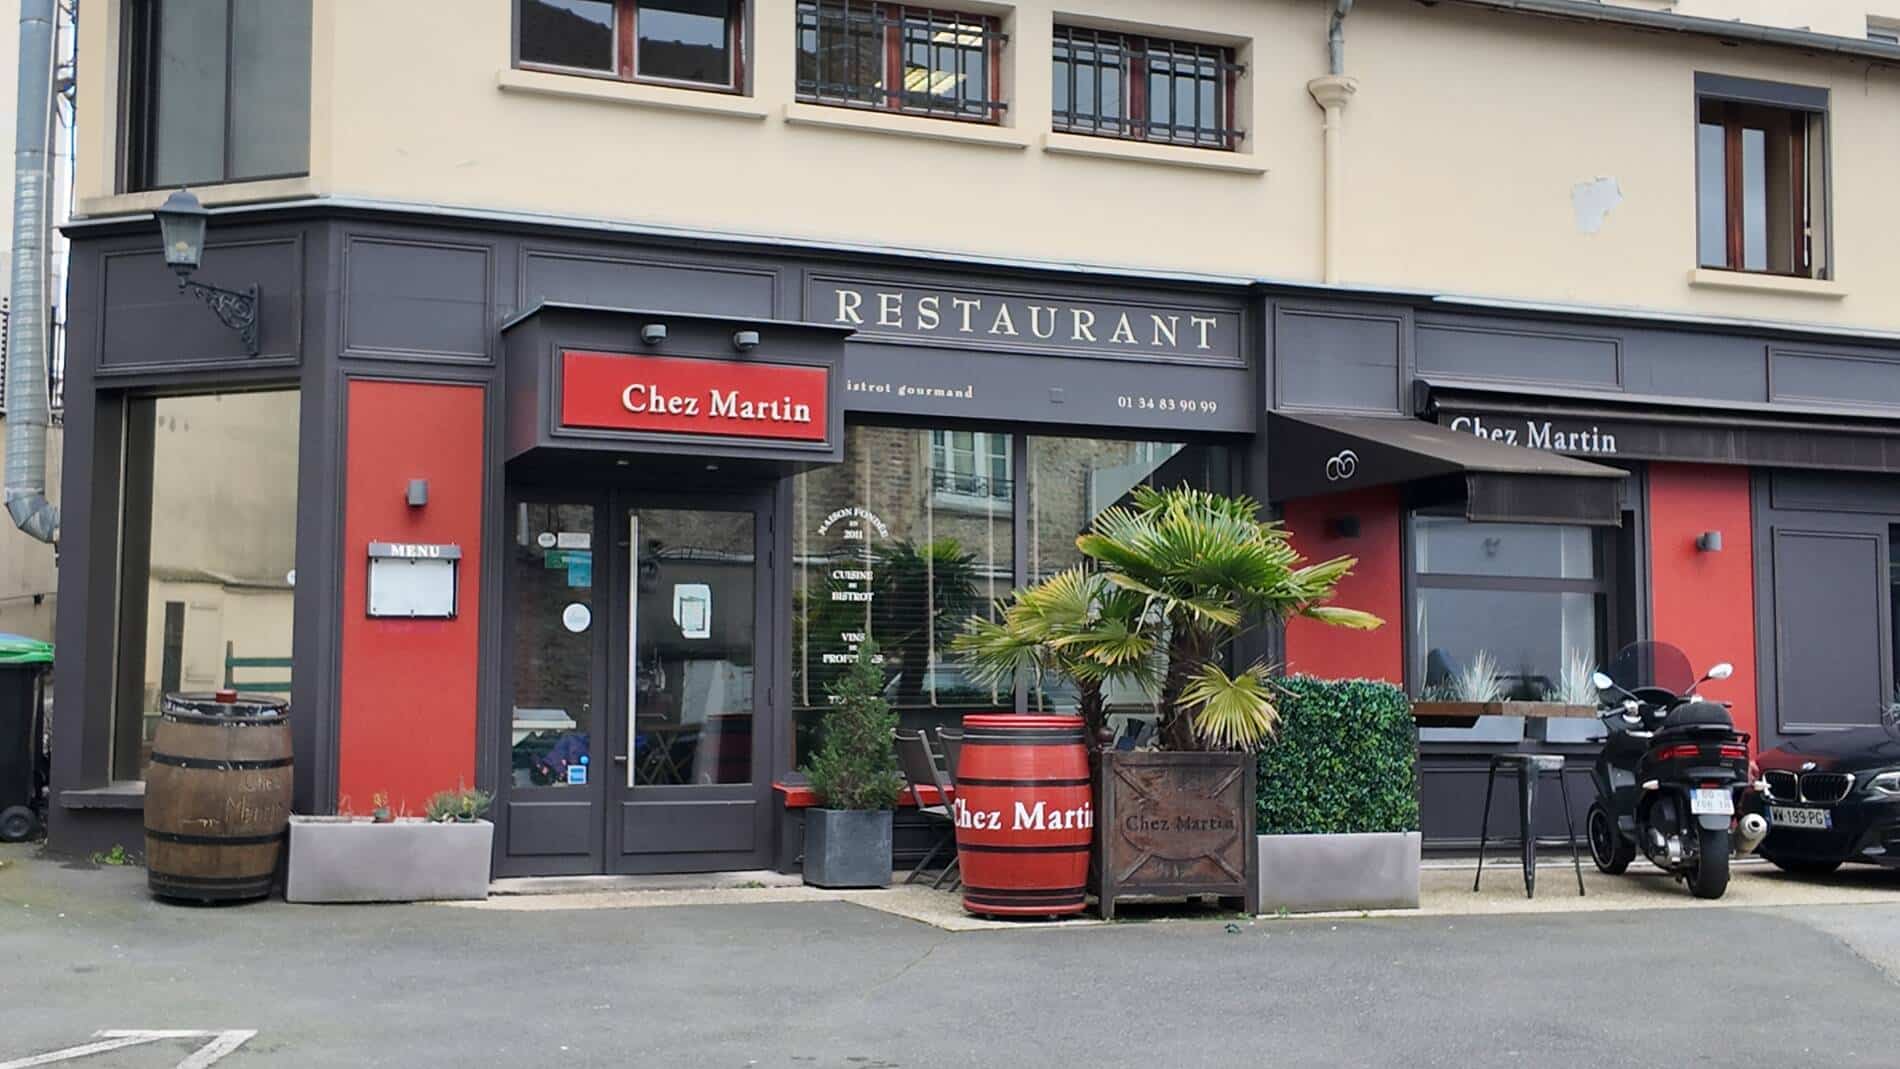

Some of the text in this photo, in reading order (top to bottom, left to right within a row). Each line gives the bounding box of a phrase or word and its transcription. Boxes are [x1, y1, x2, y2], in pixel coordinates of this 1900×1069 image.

[834, 288, 1217, 350] RESTAURANT
[846, 379, 973, 399] istrot gourmand
[622, 383, 812, 423] Chez Martin
[1117, 395, 1218, 413] 01 34 83 90 99
[1526, 421, 1617, 453] Martin
[817, 507, 853, 537] MAISON
[391, 543, 441, 558] MENU
[832, 570, 874, 581] CUISINE
[831, 591, 875, 602] BISTROT
[841, 632, 865, 642] VINS
[953, 797, 1002, 830] Chez
[1125, 815, 1235, 832] Chez Martin
